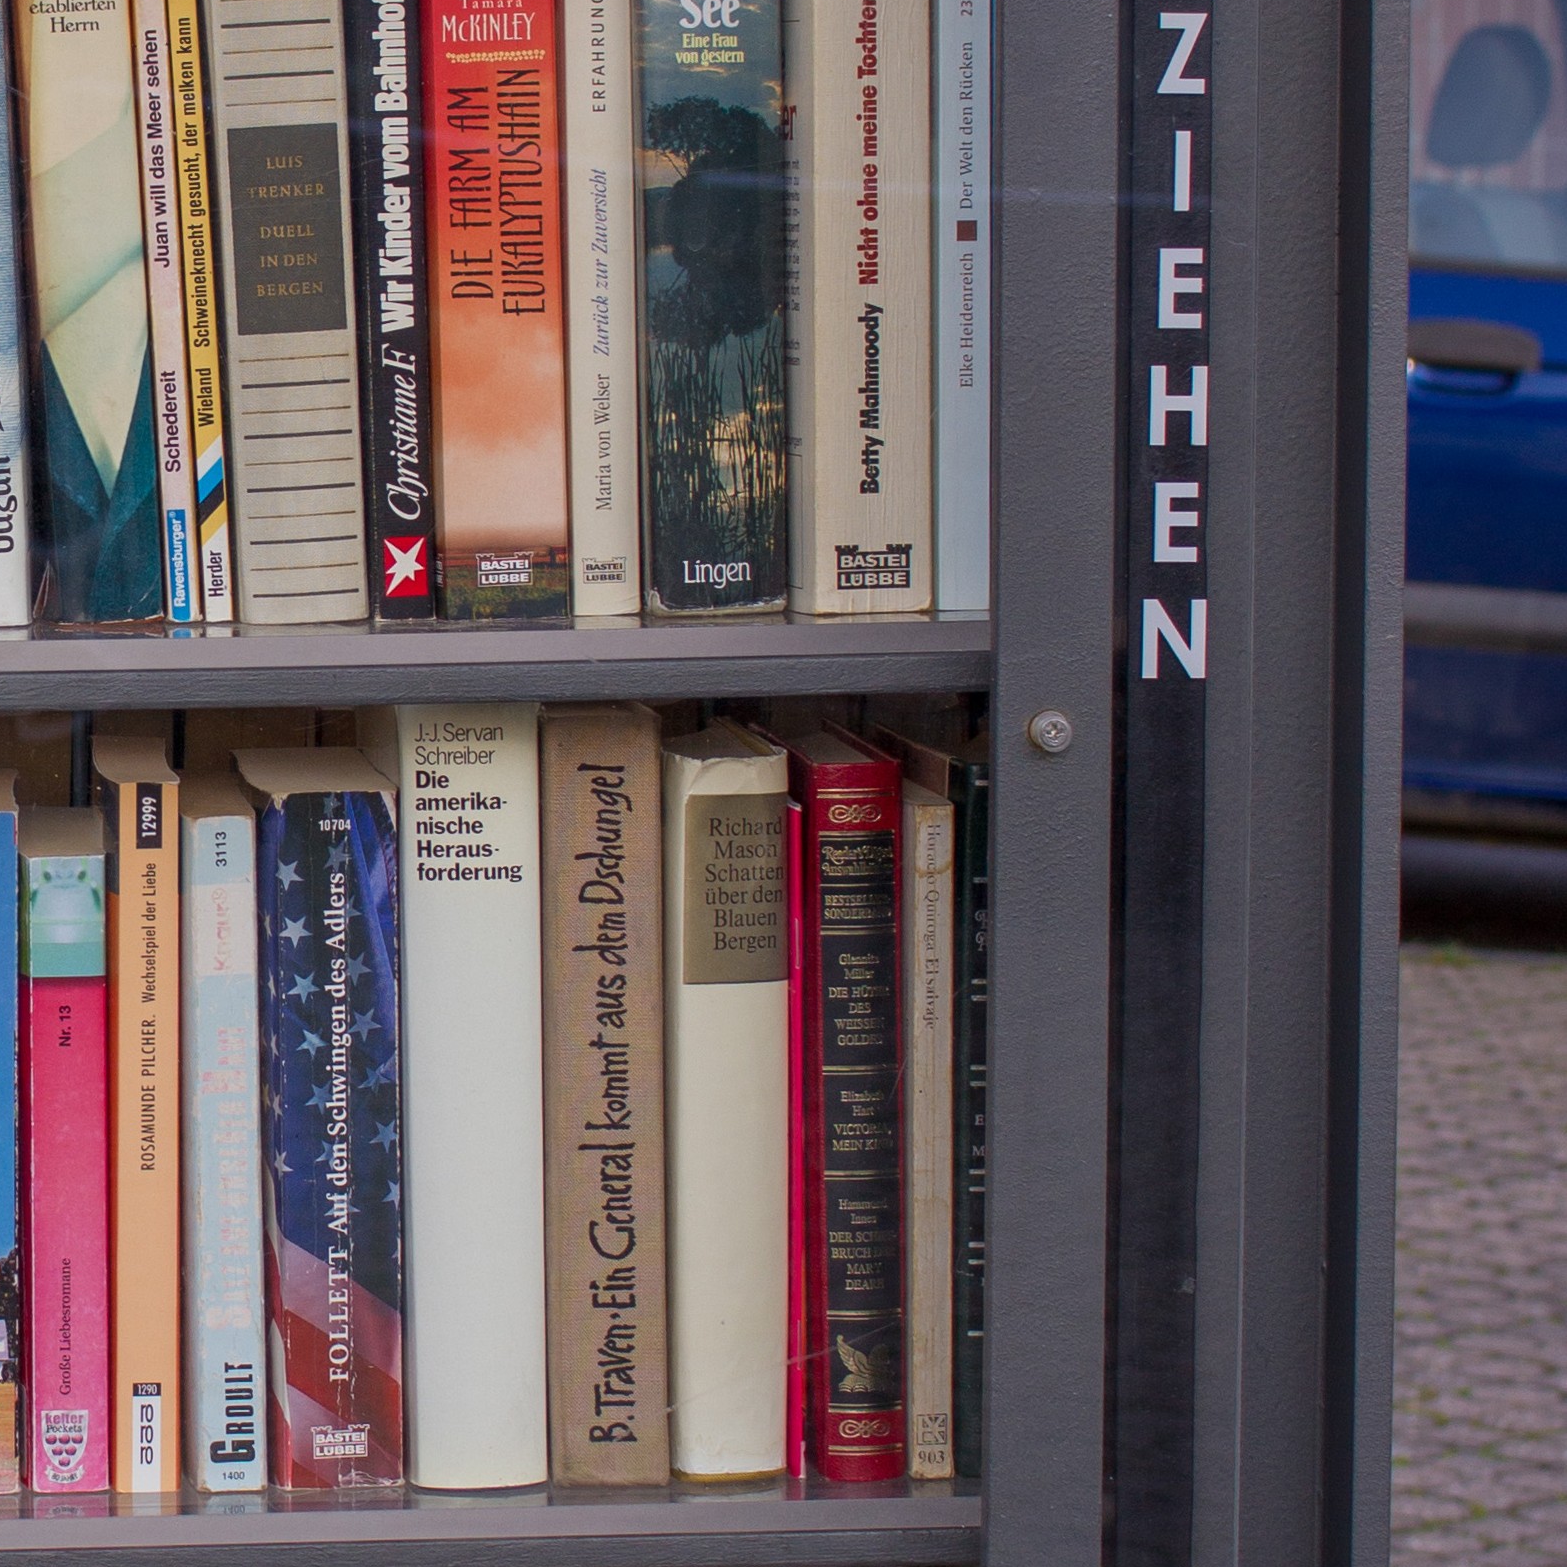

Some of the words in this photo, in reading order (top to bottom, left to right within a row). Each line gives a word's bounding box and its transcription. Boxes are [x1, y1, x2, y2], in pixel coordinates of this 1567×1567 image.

[50, 17, 100, 33] Herrn
[1141, 12, 1209, 680] ZIEHEN
[858, 302, 884, 429] Mahmoody
[161, 370, 181, 473] Schedereit
[859, 435, 884, 494] Betty
[208, 550, 225, 597] Herder
[683, 560, 751, 589] Lingen
[443, 723, 504, 741] Servan
[415, 747, 495, 765] Schreiber
[415, 771, 450, 789] Die
[415, 793, 507, 810] amerika-
[141, 796, 157, 838] 12999
[416, 817, 483, 834] nische
[708, 817, 784, 837] Richard
[215, 831, 227, 867] 3113
[417, 840, 499, 858] Heraus-
[714, 841, 778, 860] Mason
[417, 862, 523, 883] forderung
[705, 863, 786, 883] Schatten
[705, 886, 747, 907] über
[753, 887, 784, 905] den
[713, 909, 778, 928] Blauen
[713, 933, 778, 953] Bergen
[59, 1005, 72, 1021] 13
[328, 1245, 349, 1382] FOLLETT
[137, 1383, 157, 1395] 1290
[209, 1361, 256, 1464] GROULT
[222, 1471, 245, 1481] 1400
